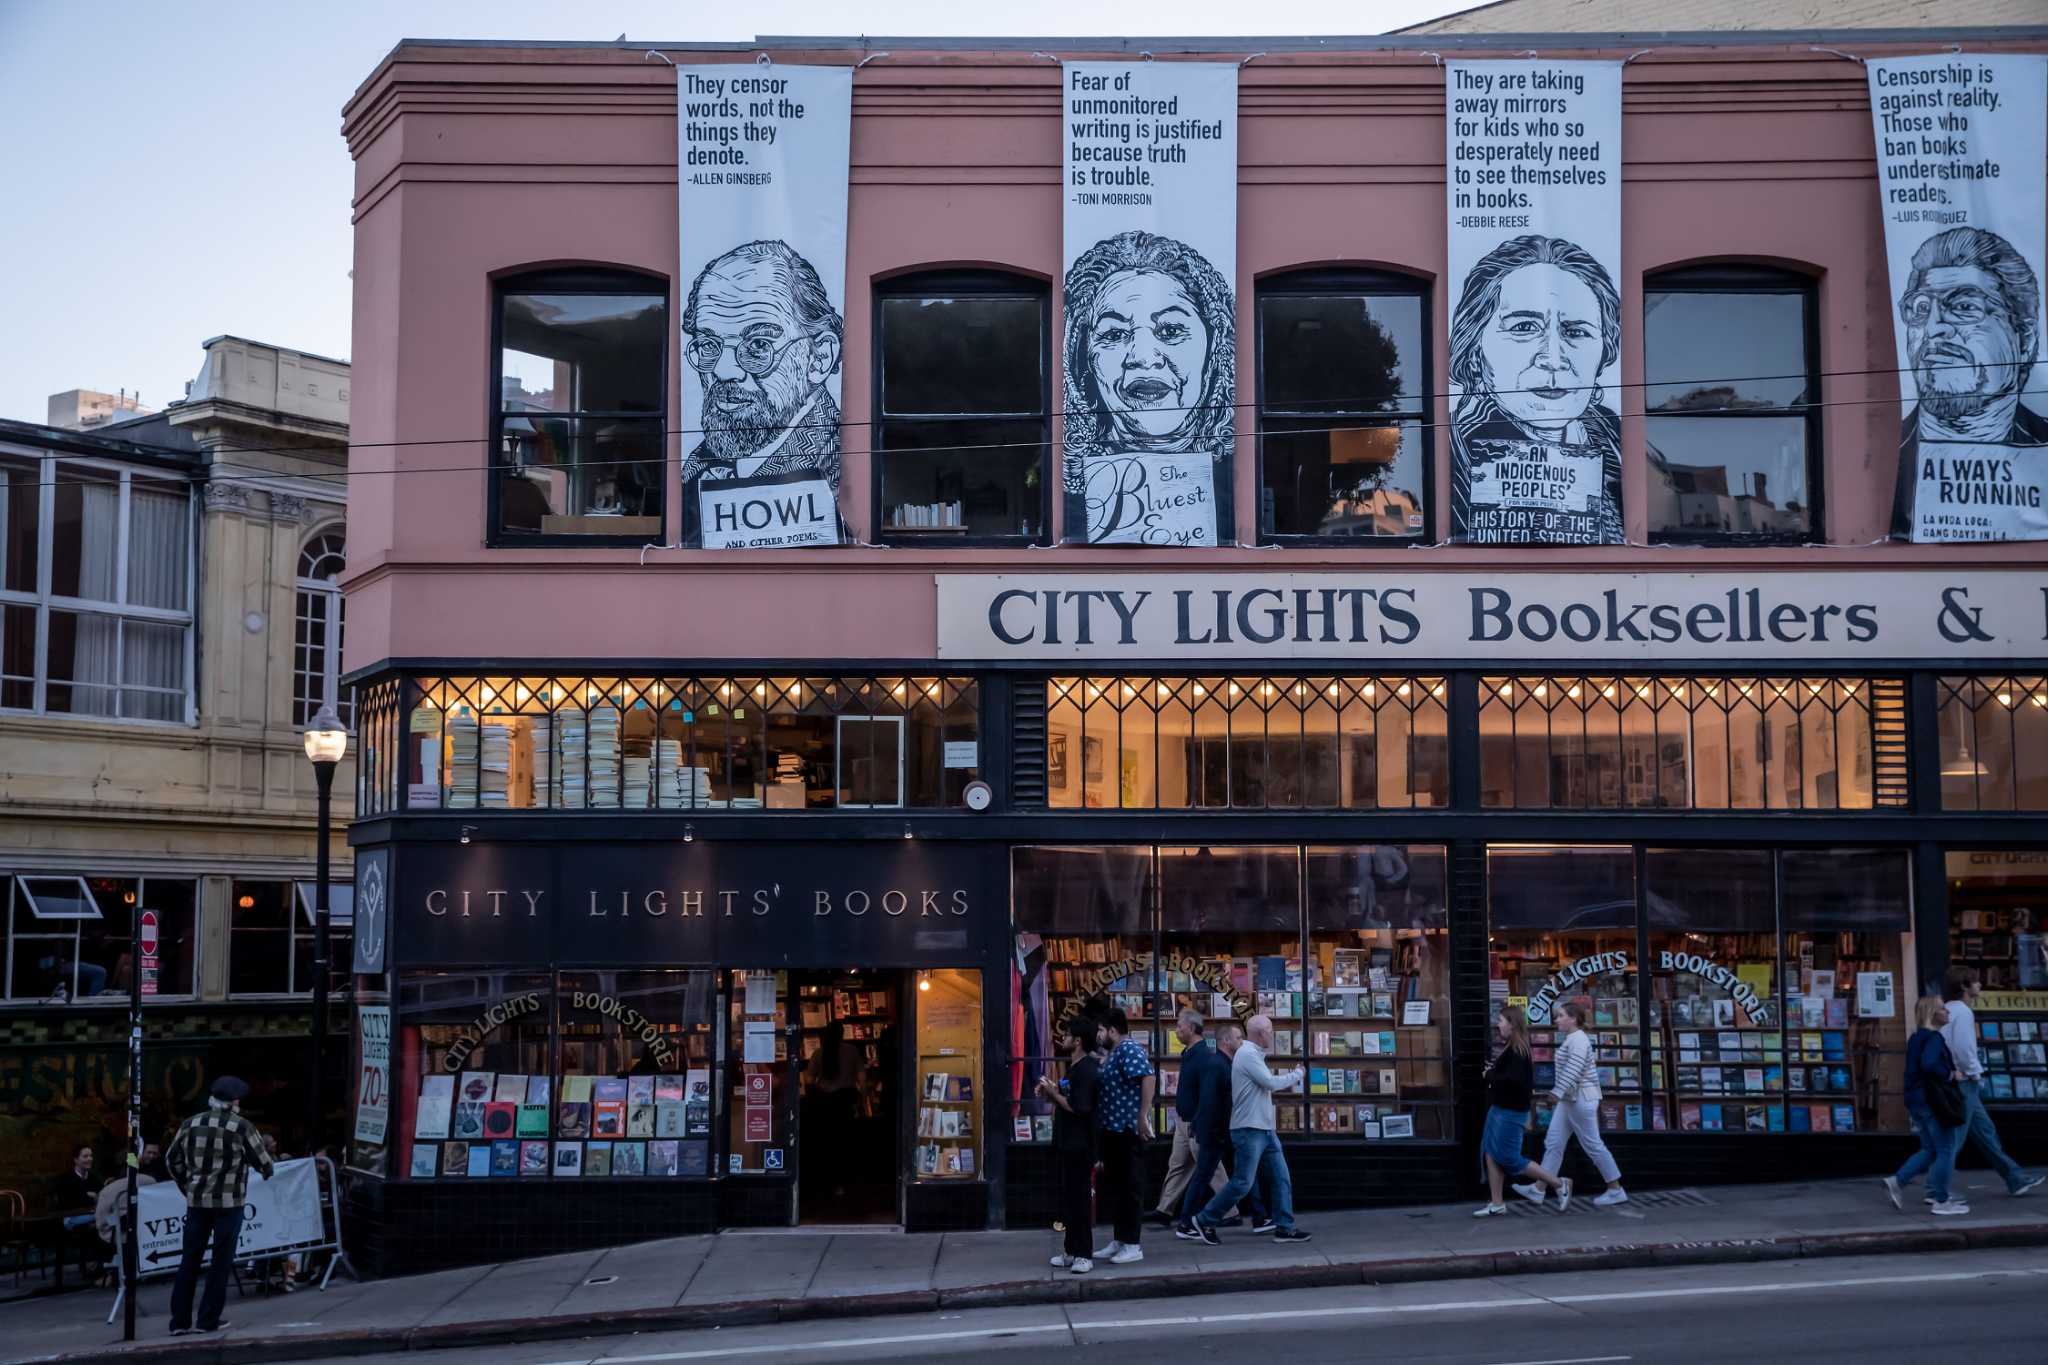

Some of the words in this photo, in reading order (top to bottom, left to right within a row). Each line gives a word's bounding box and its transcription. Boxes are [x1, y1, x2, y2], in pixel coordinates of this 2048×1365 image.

[1073, 71, 1109, 90] Fear
[1115, 72, 1130, 90] of
[1454, 70, 1493, 94] They
[1499, 75, 1526, 89] are
[1532, 70, 1583, 95] taking
[1877, 64, 1974, 87] Censorship
[1979, 64, 1992, 83] is
[686, 75, 725, 98] They
[732, 79, 788, 94] censor
[686, 97, 743, 118] words,
[750, 99, 774, 117] not
[778, 99, 804, 118] the
[1072, 95, 1177, 115] unmonitored
[1455, 99, 1498, 118] away
[1505, 94, 1566, 113] mirrors
[1880, 89, 1944, 113] against
[1948, 88, 2002, 112] reality.
[687, 122, 739, 145] things
[744, 121, 776, 144] they
[1072, 118, 1130, 143] writing
[1137, 119, 1149, 138] is
[1154, 119, 1222, 143] justified
[1455, 117, 1478, 136] for
[1485, 115, 1519, 136] kids
[1525, 118, 1558, 137] who
[1565, 123, 1584, 137] so
[1881, 113, 1933, 133] Those
[1938, 112, 1967, 131] who
[688, 145, 748, 165] denote.
[1072, 142, 1142, 161] because
[1148, 143, 1185, 163] truth
[1456, 141, 1552, 166] desperately
[1559, 142, 1599, 160] need
[1885, 138, 1916, 156] ban
[1922, 136, 1966, 156] books
[727, 173, 771, 185] GINSBERG
[1072, 166, 1085, 185] is
[1091, 166, 1153, 186] trouble.
[1455, 166, 1470, 184] to
[1477, 170, 1505, 184] see
[1511, 165, 1607, 185] themselves
[1888, 159, 2000, 181] underestimate
[1102, 194, 1151, 205] MORRISON
[1456, 188, 1470, 208] in
[1477, 188, 1532, 208] books.
[1890, 183, 1952, 204] readers.
[1499, 216, 1528, 227] REESE
[1529, 447, 1548, 462] AN
[1158, 464, 1191, 482] The
[1495, 463, 1576, 484] INDIGENOUS
[1923, 458, 2012, 482] ALWAYS
[1084, 456, 1208, 544] Bluest
[1940, 481, 2040, 507] RUNNING
[714, 493, 825, 532] HOWL
[1474, 511, 1536, 529] HISTORY
[1545, 513, 1561, 530] OF
[1569, 516, 1595, 533] THE
[1923, 515, 1935, 525] LA
[1938, 515, 1961, 526] VIDA
[1140, 512, 1206, 546] Eye
[1479, 528, 1530, 543] UNITED
[1539, 530, 1591, 544] STATES
[1923, 528, 1949, 538] GANG
[1952, 529, 1977, 539] DAYS
[1979, 531, 1990, 540] IN
[725, 541, 746, 549] AND
[751, 537, 784, 547] OTHER
[787, 533, 818, 543] POEMS
[989, 590, 1151, 645] CITY
[1173, 589, 1420, 644] LIGHTS
[1468, 588, 1878, 646] Booksellers
[1938, 588, 1995, 643] &
[427, 890, 543, 916] CITY
[815, 890, 968, 915] BOOKS
[1082, 953, 1149, 998] LIGHTS
[1527, 980, 1561, 1023] CITY
[1556, 951, 1629, 988] LIGHTS
[1659, 950, 1768, 1026] BOOKSTORE
[361, 1013, 389, 1039] CITY
[442, 1029, 479, 1073] CITY
[474, 992, 541, 1036] LIGHTS
[572, 991, 676, 1067] BOOKSTORE
[245, 1221, 263, 1232] Ave
[142, 1236, 179, 1250] entrance
